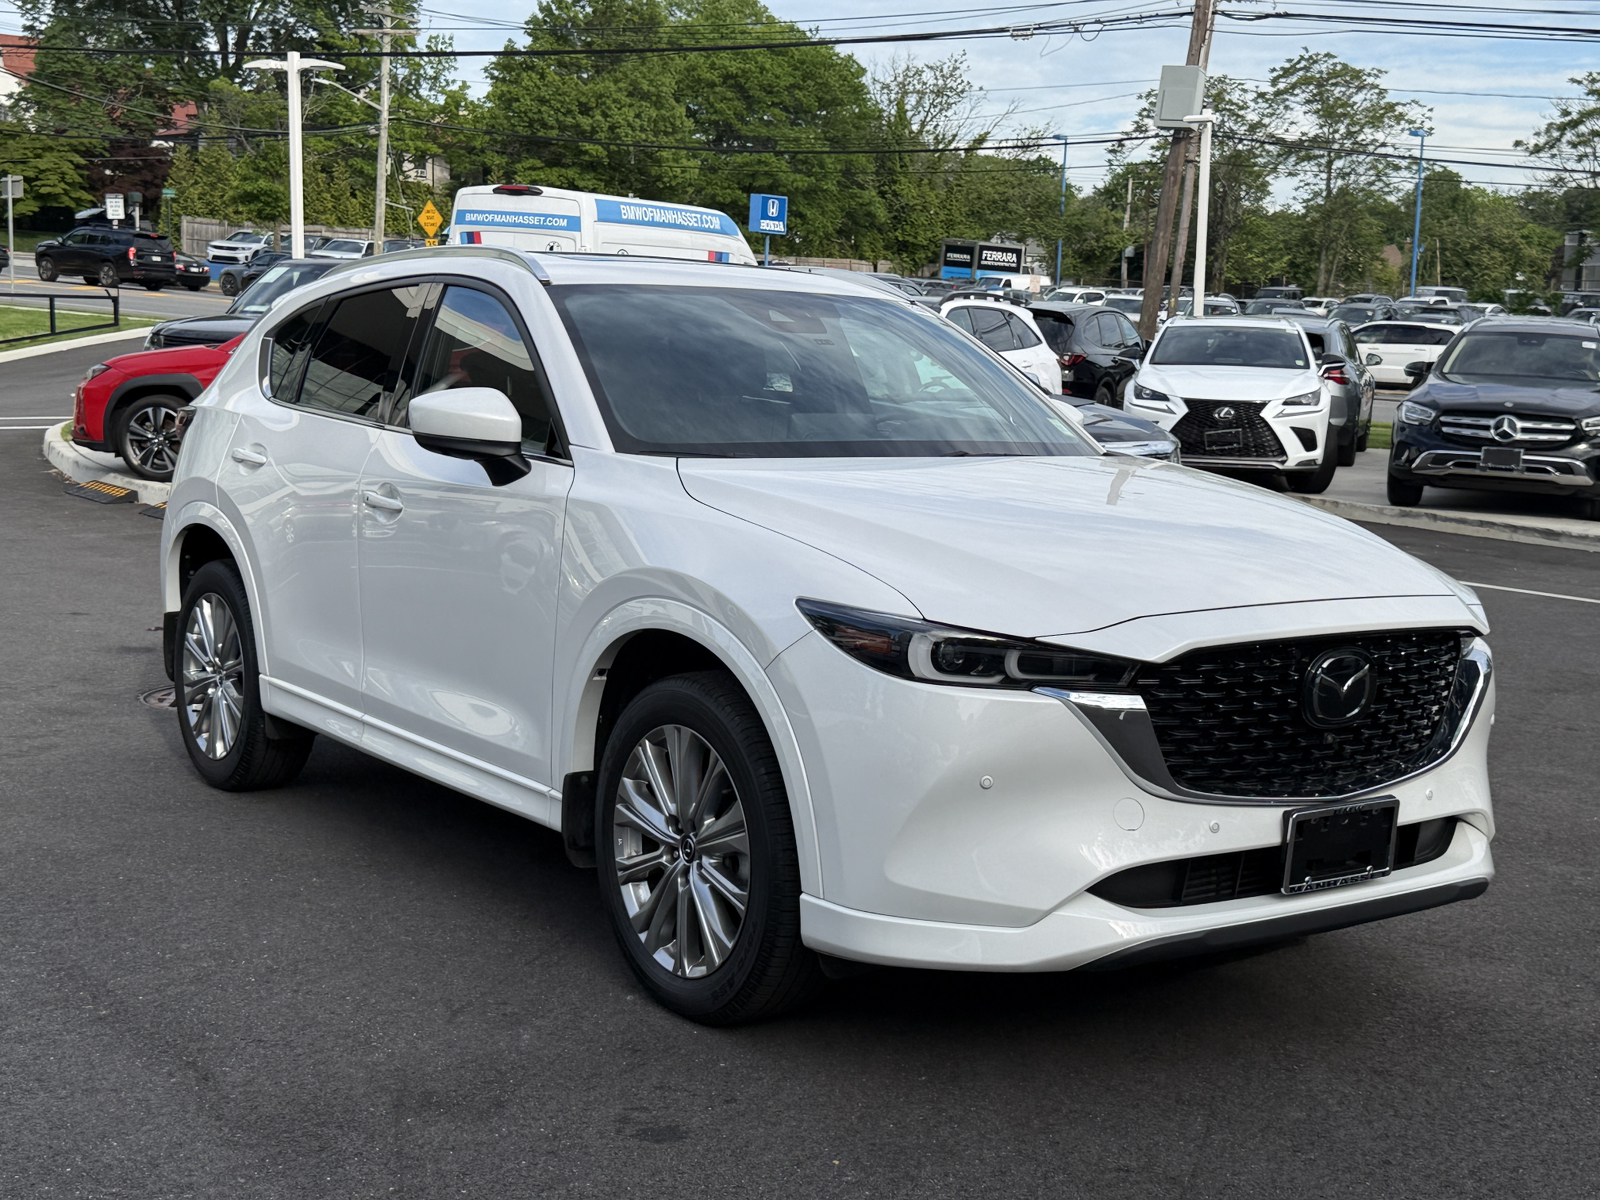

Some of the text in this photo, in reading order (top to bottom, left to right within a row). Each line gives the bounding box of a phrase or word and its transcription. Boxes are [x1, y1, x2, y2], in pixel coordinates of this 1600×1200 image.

[465, 212, 567, 227] BMWOFMANHASSET.COM
[620, 205, 720, 230] BMWOFMANHASSET.COM
[982, 250, 1017, 262] FERRARA
